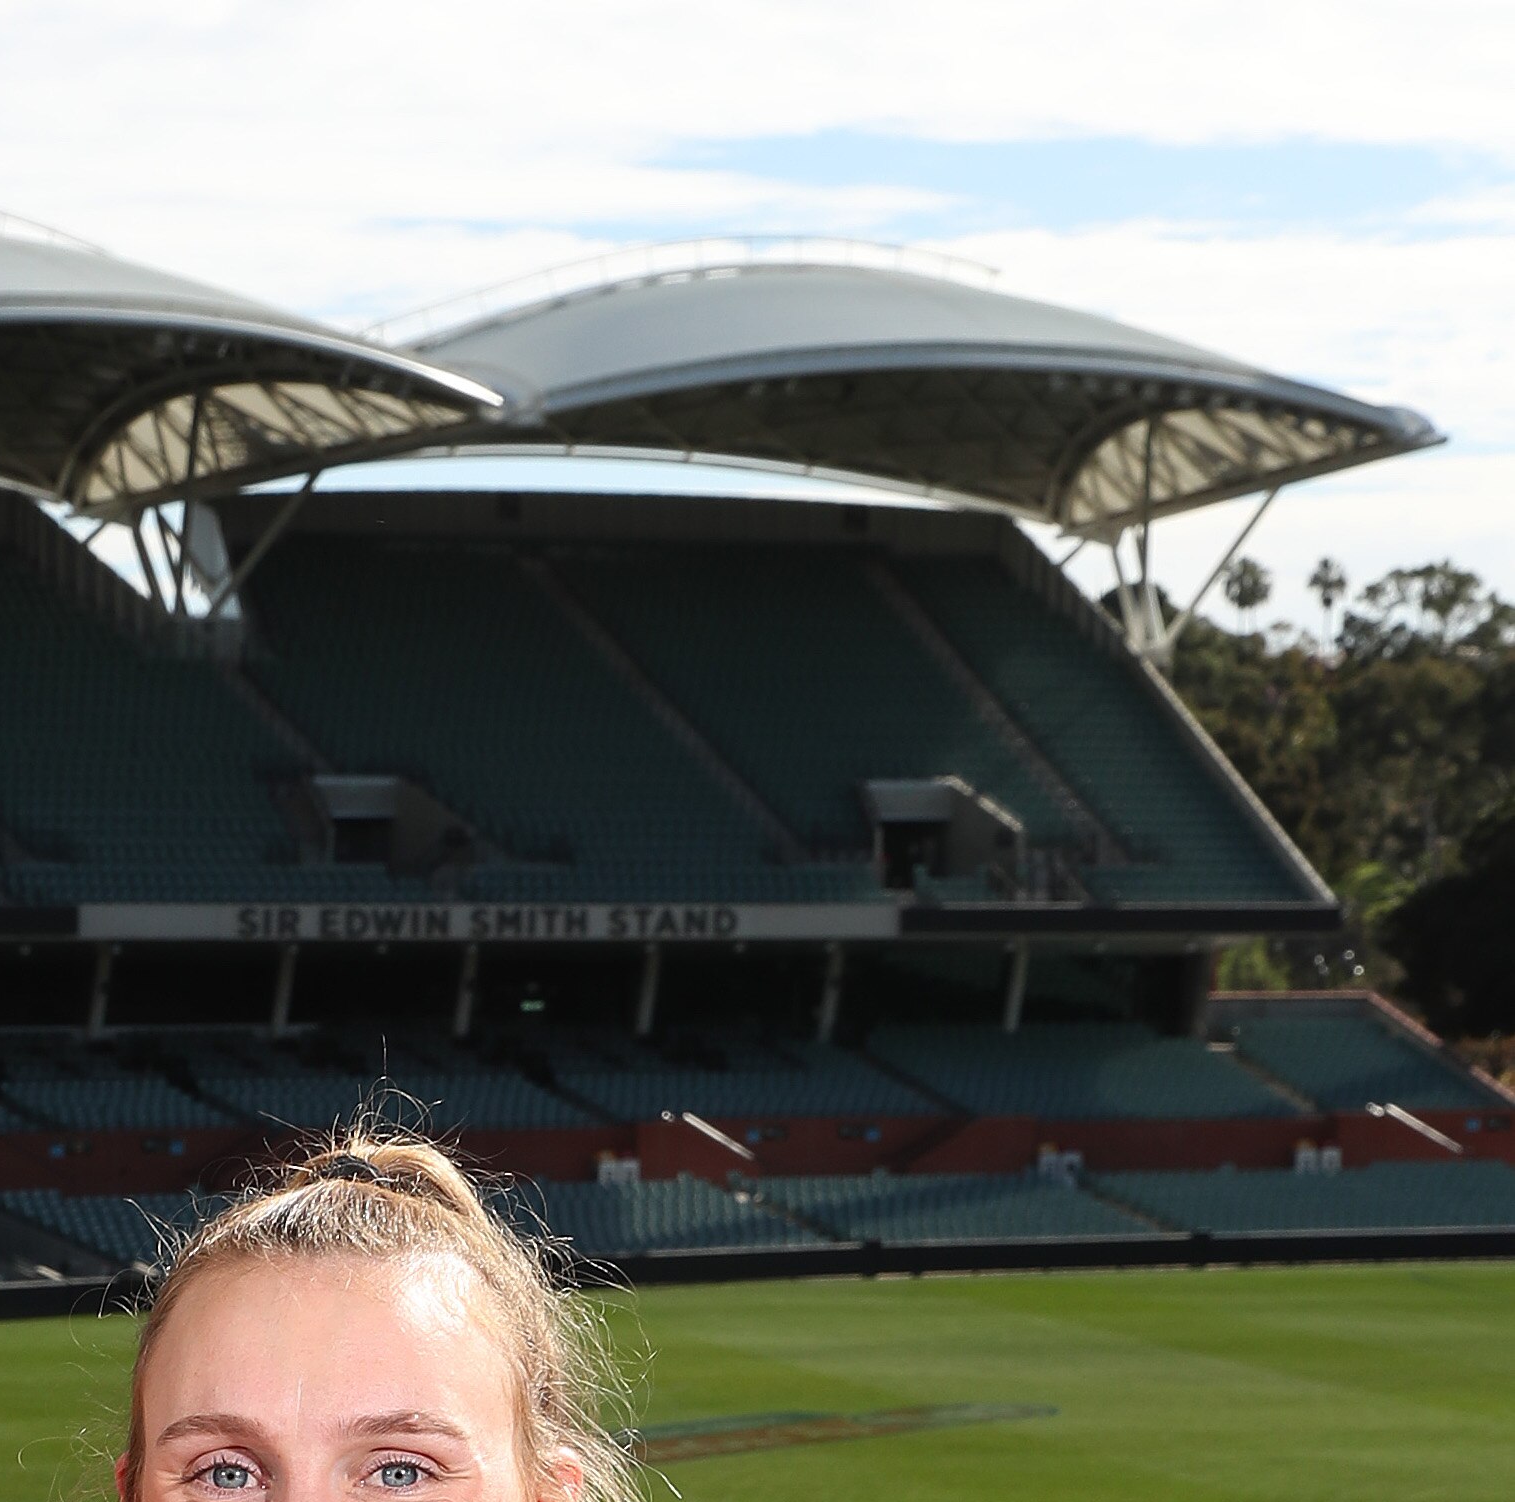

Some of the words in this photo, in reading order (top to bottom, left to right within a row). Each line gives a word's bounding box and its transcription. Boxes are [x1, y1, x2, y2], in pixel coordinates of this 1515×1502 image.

[237, 907, 300, 939] SIR
[319, 907, 451, 939] EDWIN
[470, 907, 587, 939] SMITH
[607, 907, 740, 939] STAND
